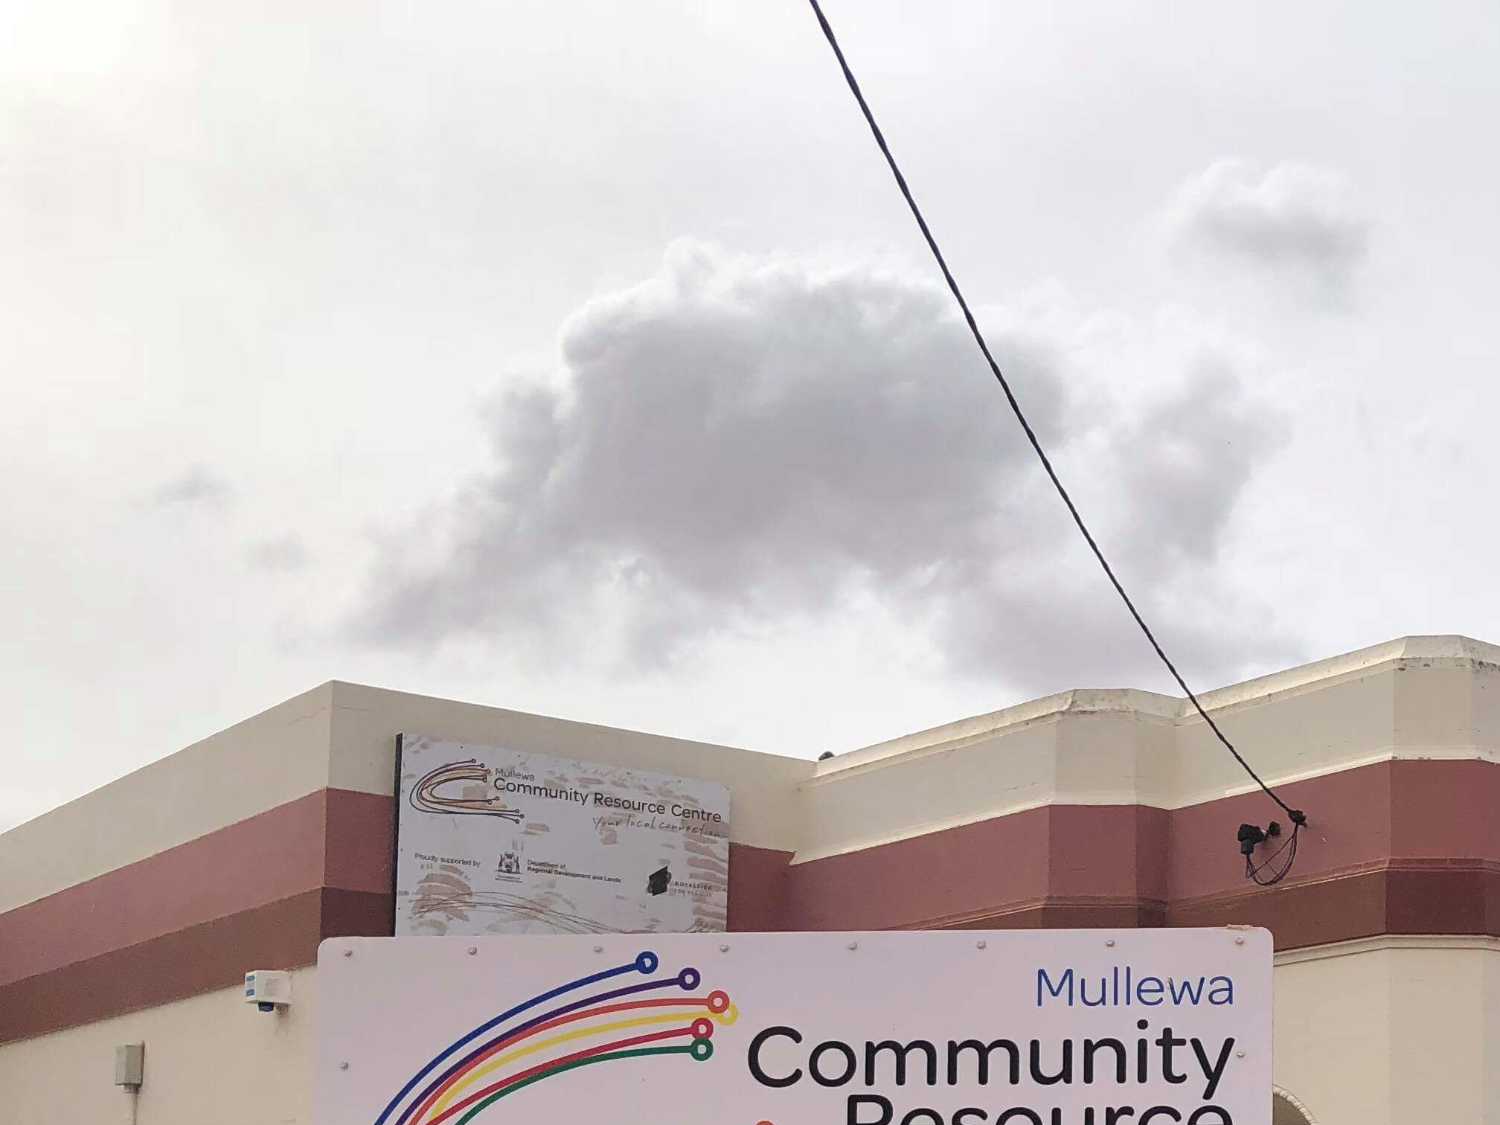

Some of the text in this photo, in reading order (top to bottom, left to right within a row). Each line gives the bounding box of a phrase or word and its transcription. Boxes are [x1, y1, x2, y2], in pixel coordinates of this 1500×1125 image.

[495, 768, 535, 781] Mullewa
[494, 777, 722, 823] Community Resource Centre
[1036, 966, 1234, 1007] Mullewa
[746, 1019, 1236, 1101] Community
